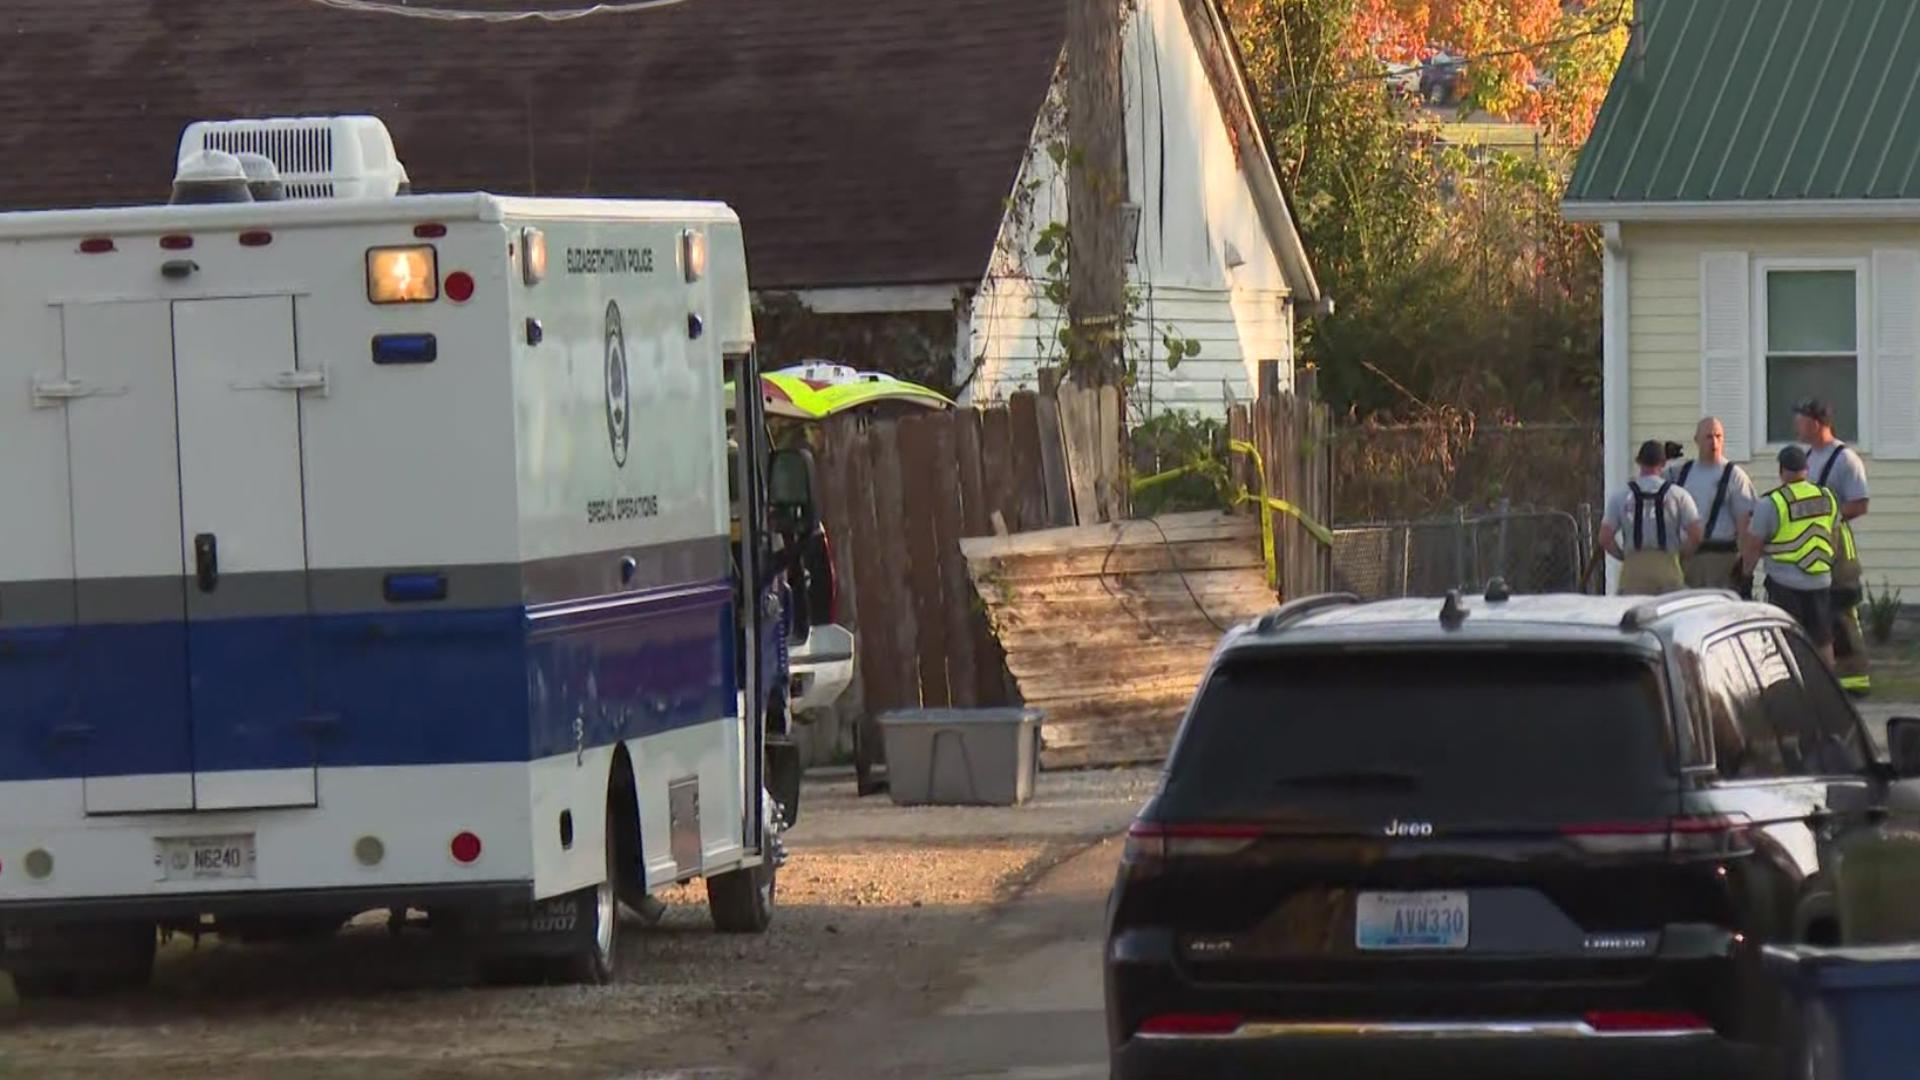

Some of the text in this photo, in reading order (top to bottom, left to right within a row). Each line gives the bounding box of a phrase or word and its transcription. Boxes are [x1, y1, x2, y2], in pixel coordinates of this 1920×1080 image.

[567, 247, 654, 273] ELIZABETHTOWN POLICE
[587, 495, 658, 524] SPECIAL OPERATIONS
[1384, 819, 1433, 836] Jeep
[194, 848, 240, 868] N6240
